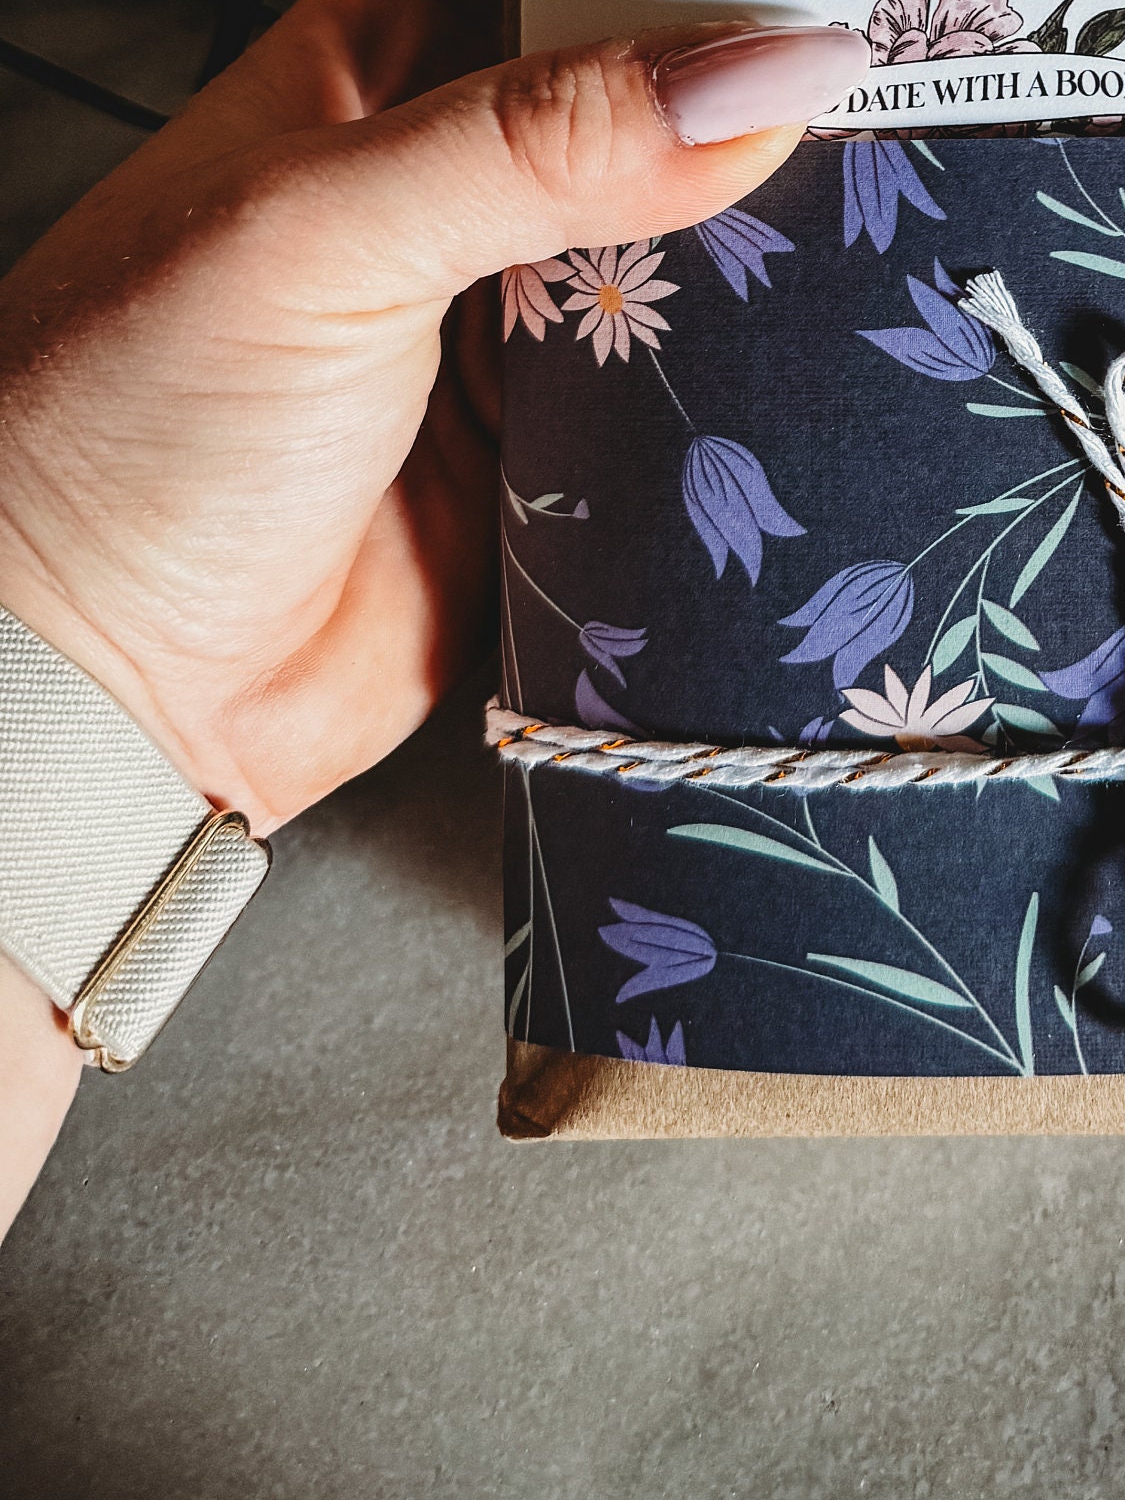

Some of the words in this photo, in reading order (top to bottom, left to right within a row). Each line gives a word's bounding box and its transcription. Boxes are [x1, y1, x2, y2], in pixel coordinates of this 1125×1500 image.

[846, 80, 926, 114] DATE
[932, 71, 1020, 104] WITH
[1028, 70, 1052, 100] A
